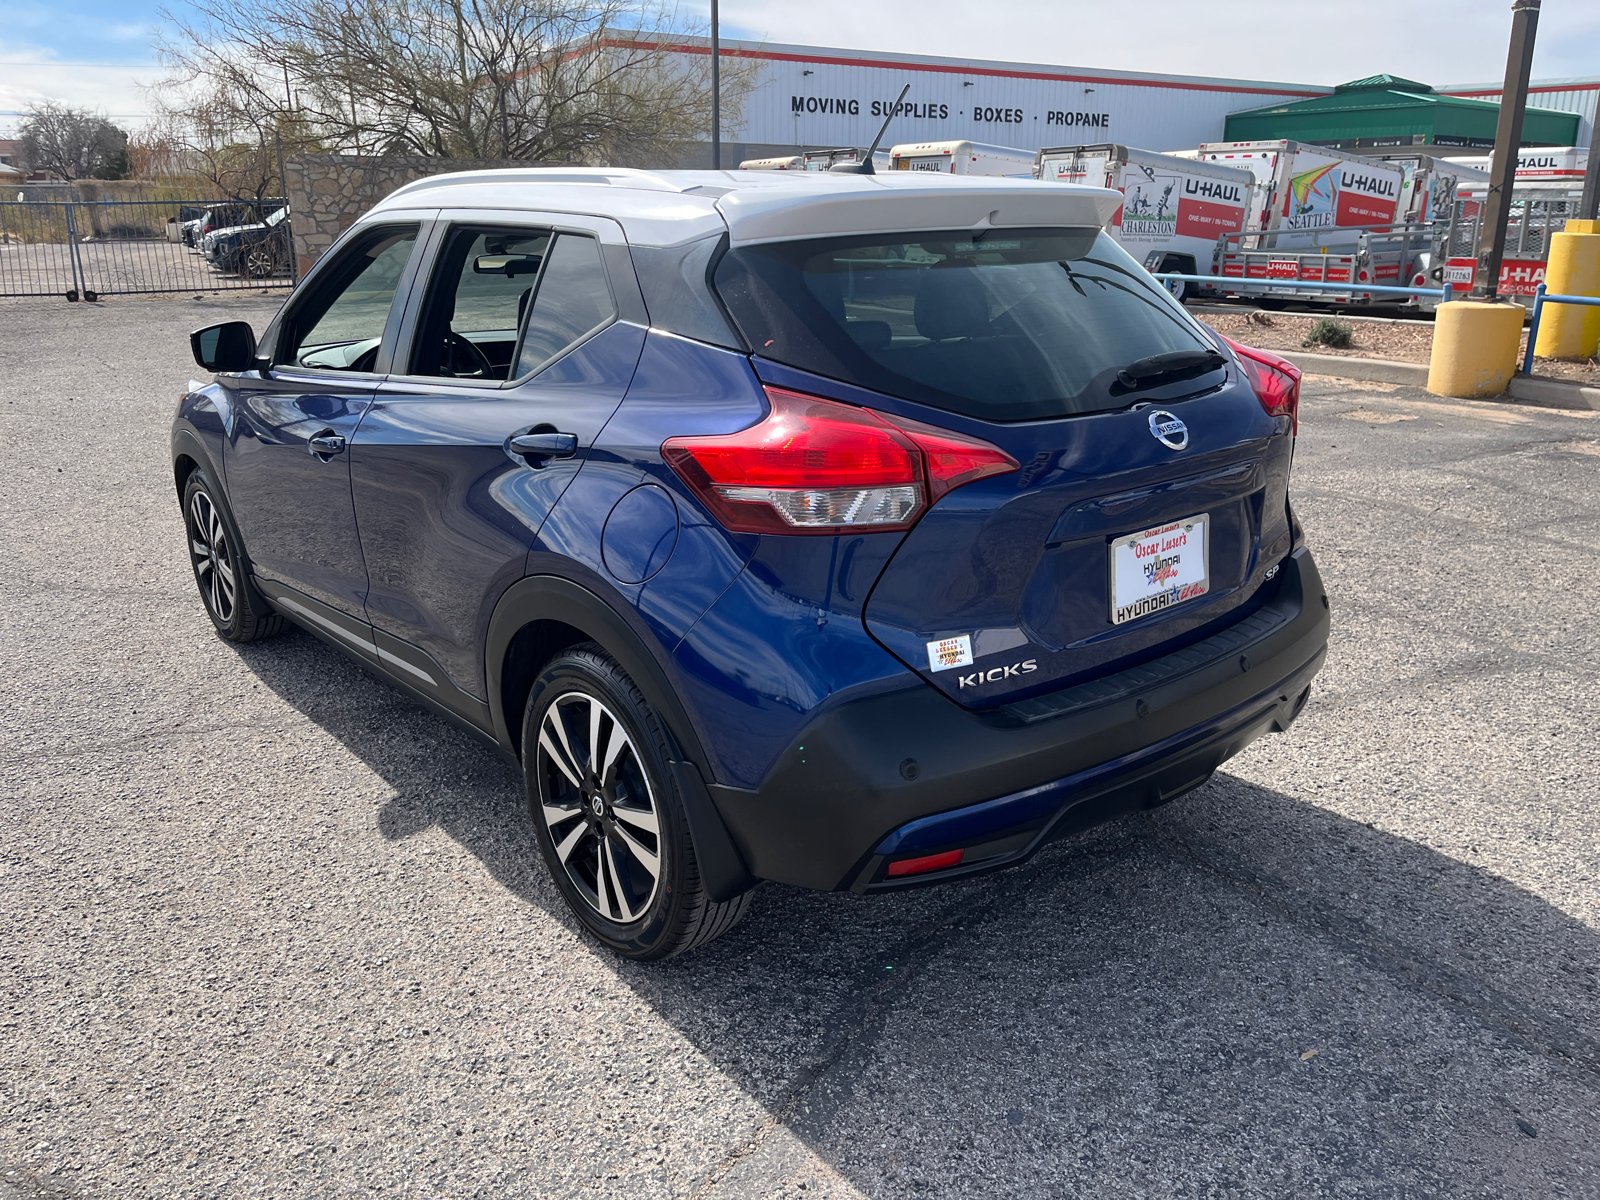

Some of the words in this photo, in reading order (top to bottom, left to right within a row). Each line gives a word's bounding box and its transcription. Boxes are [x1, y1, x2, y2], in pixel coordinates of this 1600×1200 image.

[791, 96, 860, 115] MOVING
[871, 100, 949, 120] SUPPLIES
[973, 106, 1024, 124] BOXES
[1046, 111, 1110, 128] PROPANE
[912, 162, 940, 171] U-HAUL
[1185, 178, 1241, 202] U-HAUL
[1341, 171, 1395, 197] U-HAUL
[1348, 206, 1368, 215] ONE-WAY
[1371, 210, 1390, 219] IN-TOWN
[1121, 220, 1172, 234] CHARLESTON
[1188, 214, 1211, 224] ONE-WAY
[1215, 218, 1237, 228] IN-TOWN
[1288, 212, 1332, 230] SEATTLE
[1267, 263, 1298, 271] U-HAUL
[1157, 422, 1187, 434] NISSAN
[1144, 529, 1160, 538] Oscar
[1135, 542, 1160, 559] Oscar
[1161, 532, 1187, 552] Leeser's
[1143, 554, 1181, 574] HYUNDAI
[1117, 593, 1170, 622] HYUNDAI
[1180, 585, 1191, 601] El
[939, 639, 958, 647] OSCAR
[940, 649, 965, 659] HYUNDAI
[957, 659, 1038, 689] KICKS
